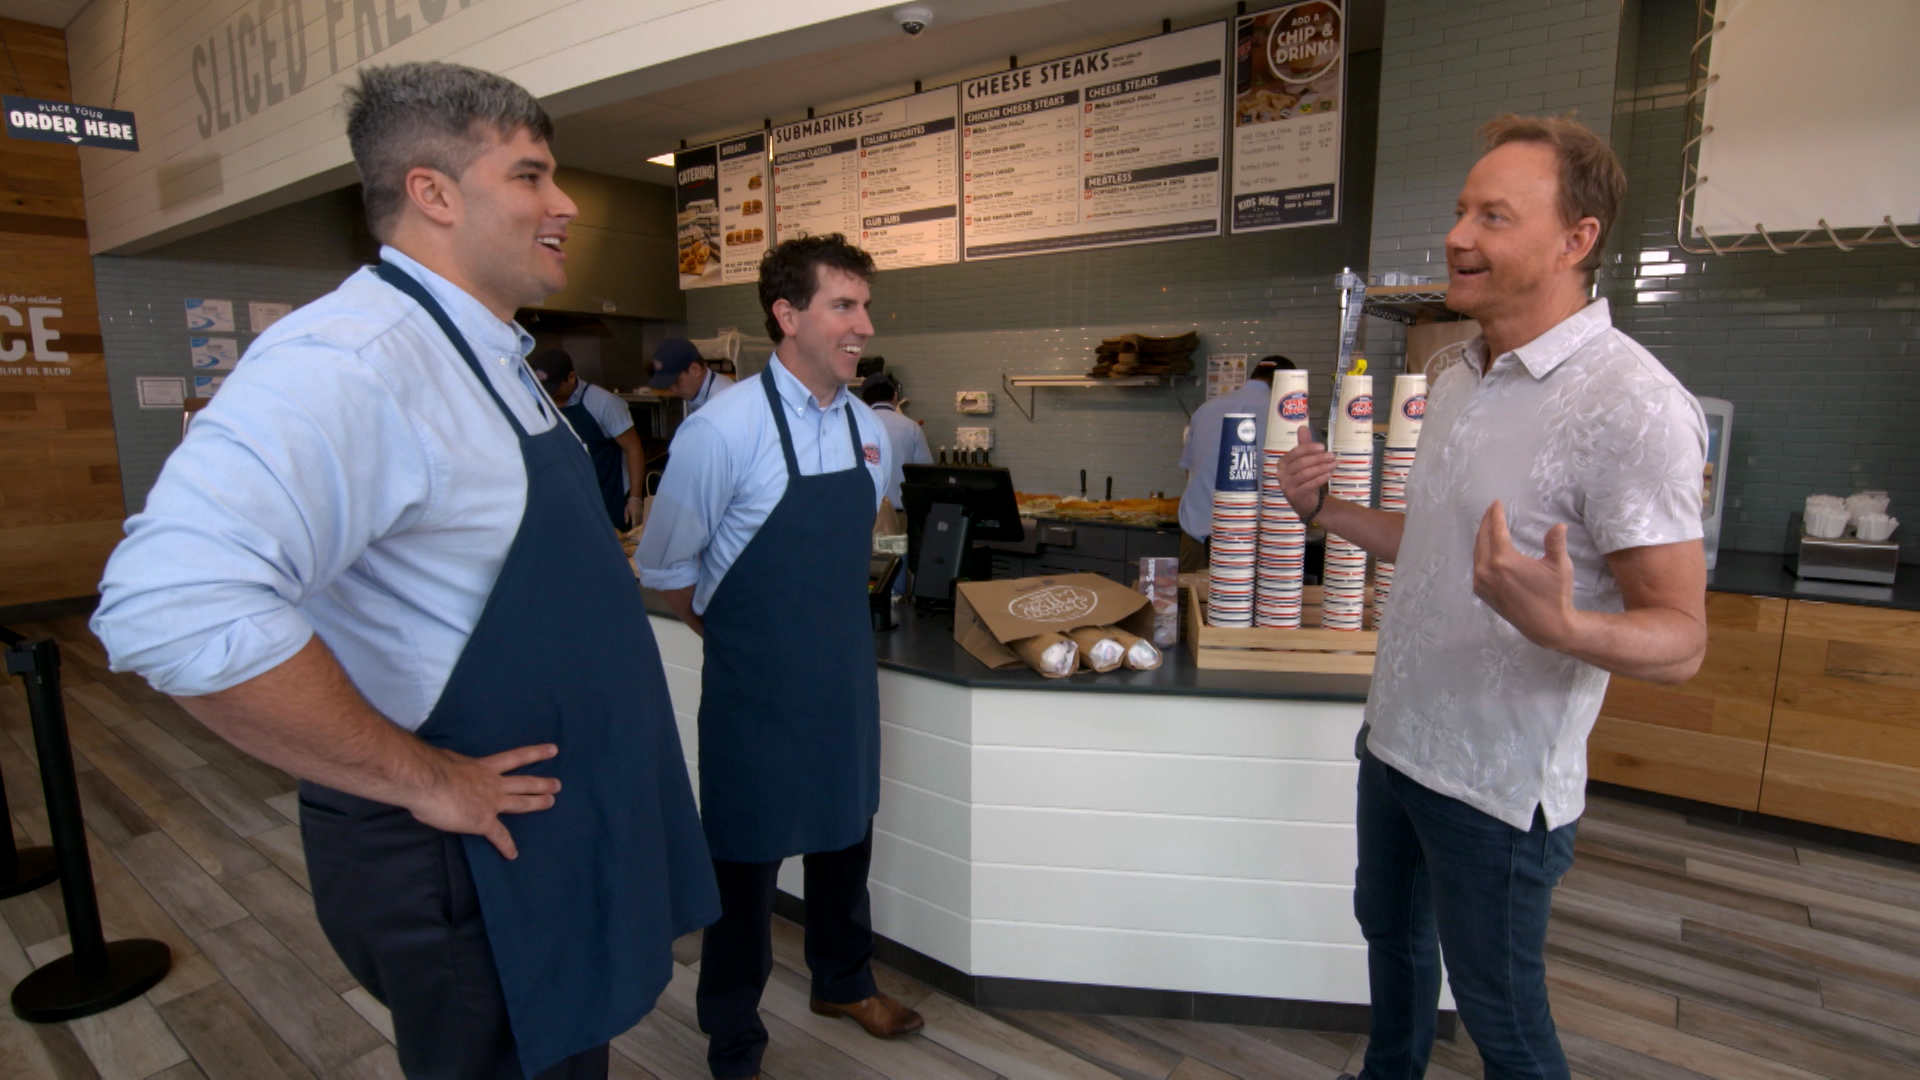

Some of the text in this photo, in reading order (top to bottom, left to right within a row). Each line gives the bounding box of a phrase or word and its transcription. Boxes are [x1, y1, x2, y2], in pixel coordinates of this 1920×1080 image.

[1292, 13, 1320, 26] ADD A
[1278, 23, 1333, 46] CHIP &
[1276, 39, 1334, 64] DRINK!
[192, 0, 307, 140] SLICED
[968, 52, 1110, 99] CHEESE STEAKS
[1088, 76, 1158, 98] CHEESE STEAKS
[38, 104, 103, 120] PLACE YOUR
[967, 96, 1064, 122] CHICKEN CHEESE STEAKS
[10, 110, 133, 140] ORDER HERE
[776, 111, 863, 143] SUBMARINES
[863, 126, 925, 146] ITALIAN FAVORITES
[678, 165, 716, 186] CATERING!
[1088, 172, 1132, 187] MEATLESS
[1258, 195, 1279, 207] MEAL
[866, 217, 882, 227] CLUB
[26, 367, 40, 376] OIL
[43, 367, 71, 376] BLEND
[1229, 469, 1257, 480] LWAYS
